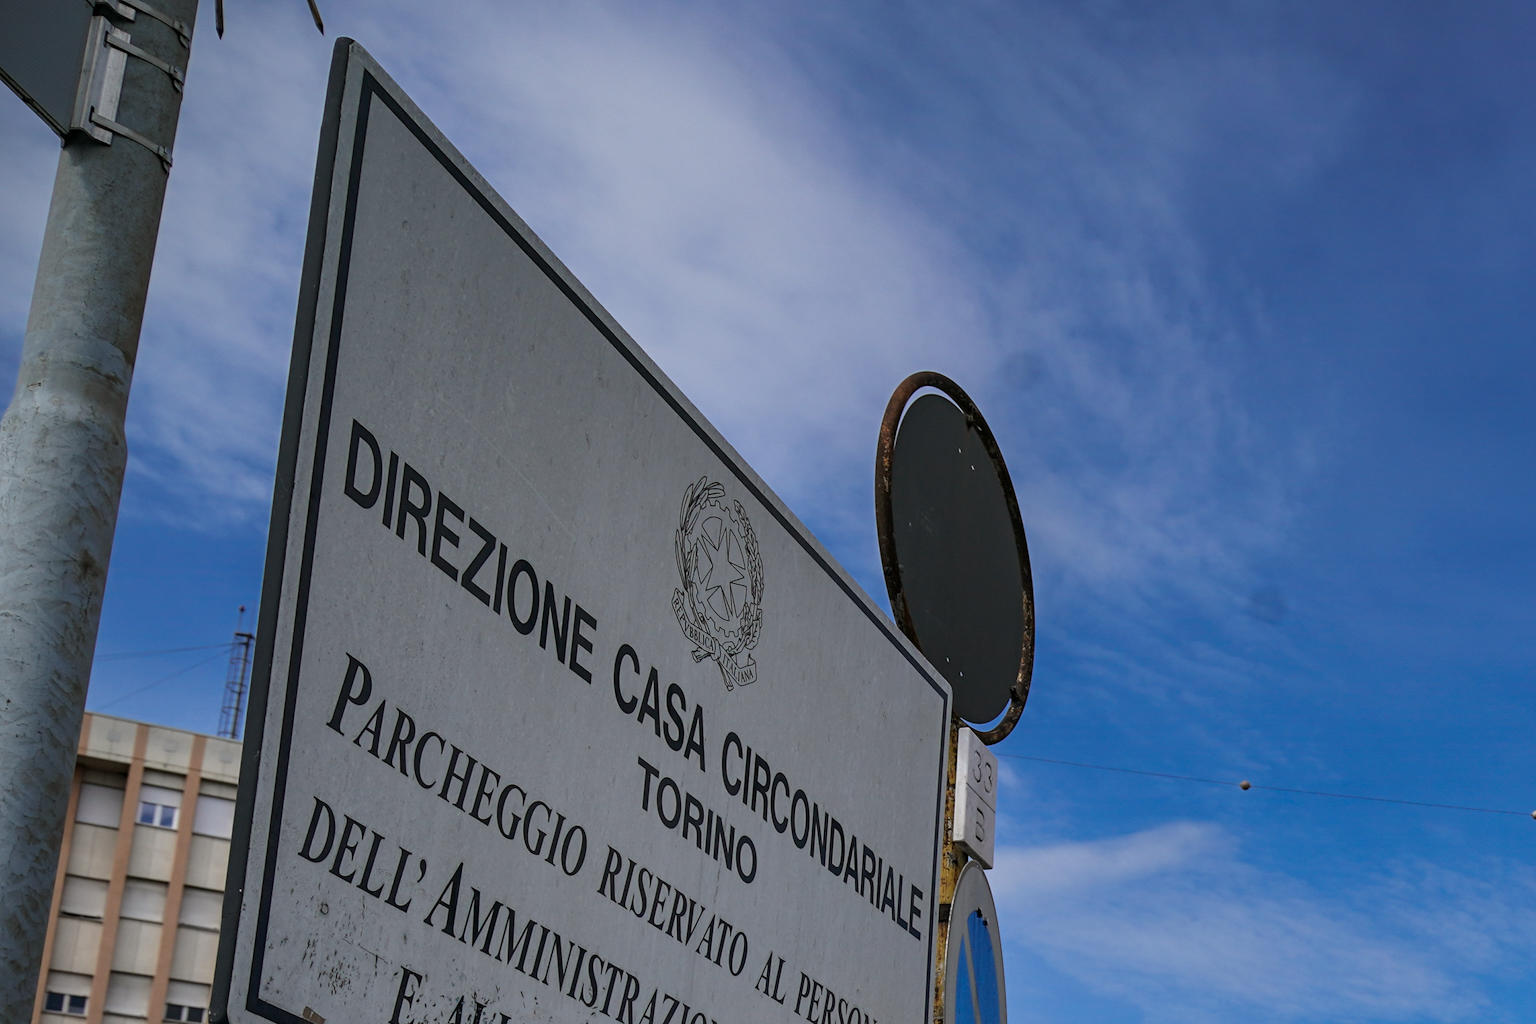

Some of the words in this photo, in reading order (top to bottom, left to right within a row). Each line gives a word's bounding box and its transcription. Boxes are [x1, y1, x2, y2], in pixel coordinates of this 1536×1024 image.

[344, 418, 598, 685] DIREZIONE
[613, 643, 706, 773] CASA
[721, 731, 924, 941] CIRCONDARIALE
[972, 749, 993, 793] 33
[326, 652, 588, 876] PARCHEGGIO
[596, 845, 749, 977] RISERVATO
[755, 950, 787, 1005] AL
[637, 756, 758, 884] TORINO
